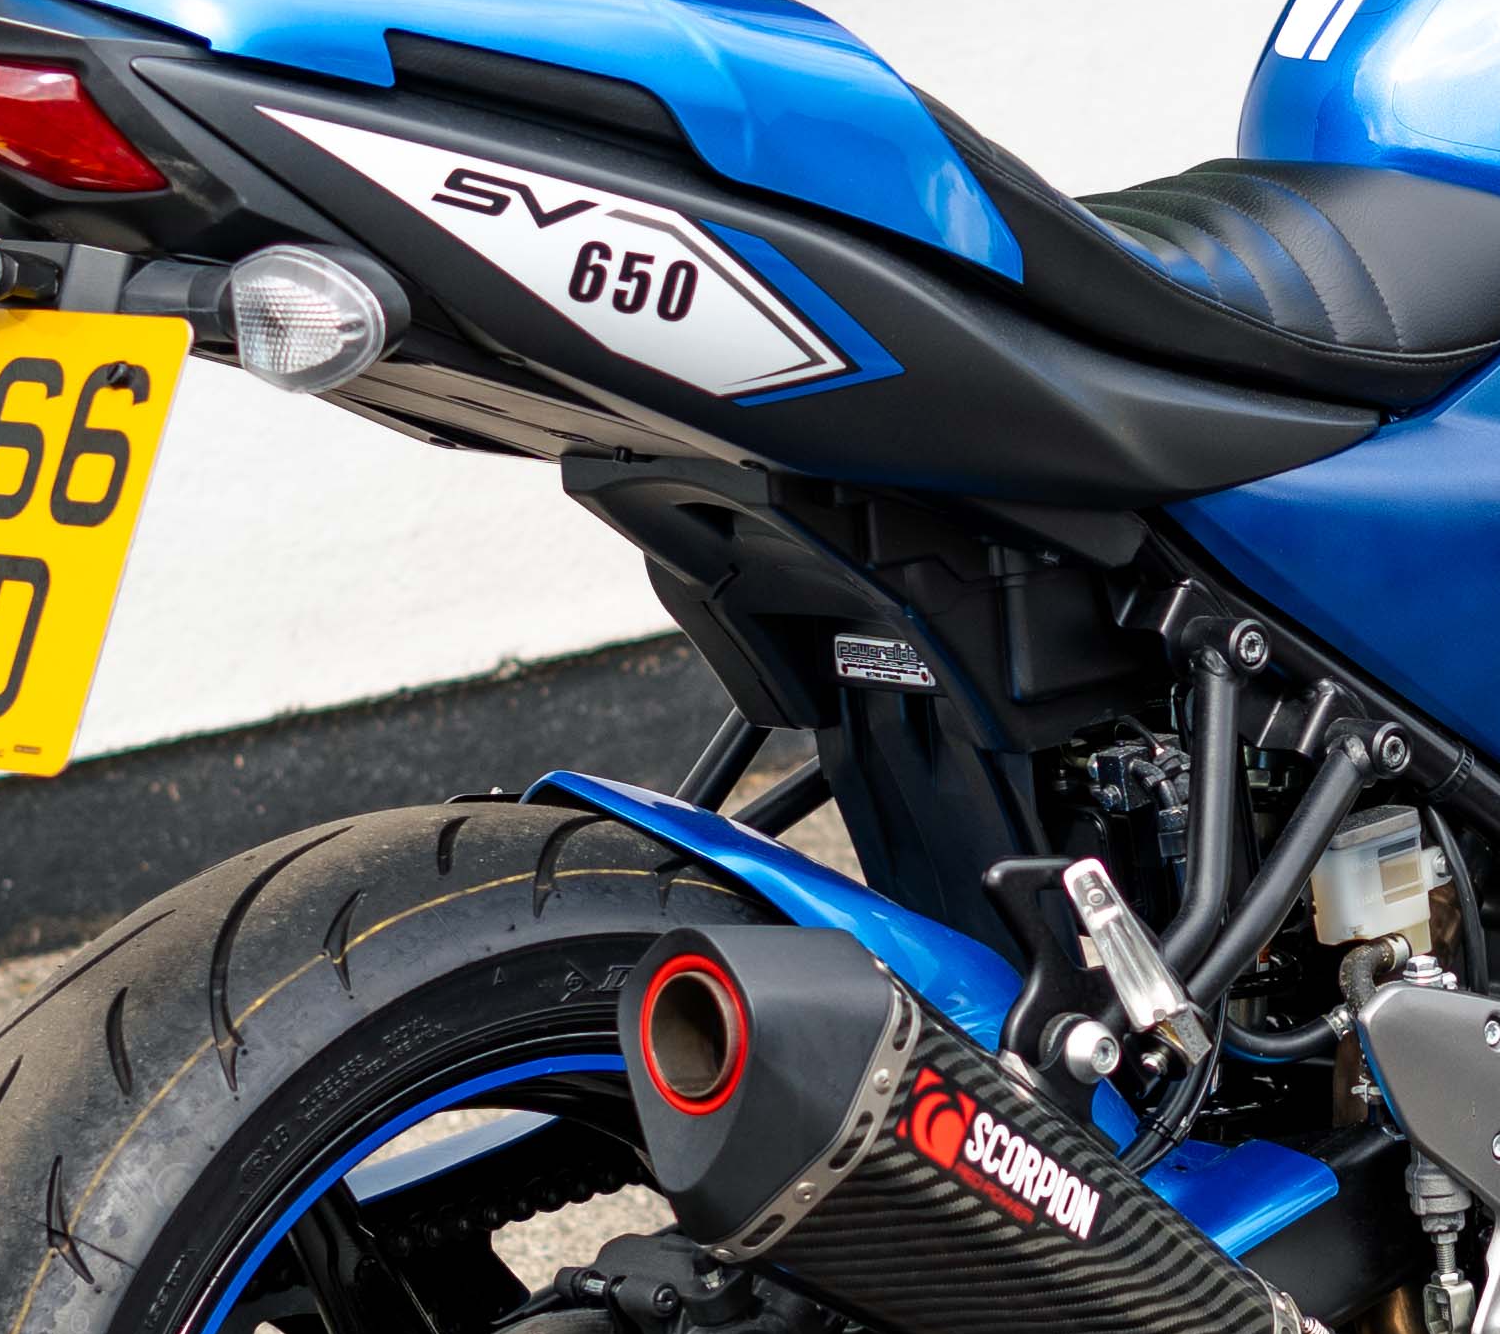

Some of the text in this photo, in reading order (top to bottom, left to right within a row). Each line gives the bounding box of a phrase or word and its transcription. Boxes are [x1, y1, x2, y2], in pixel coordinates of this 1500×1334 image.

[431, 167, 596, 229] SV
[568, 240, 699, 323] 650
[837, 641, 919, 662] powerslide
[964, 1111, 1100, 1242] SCORPION
